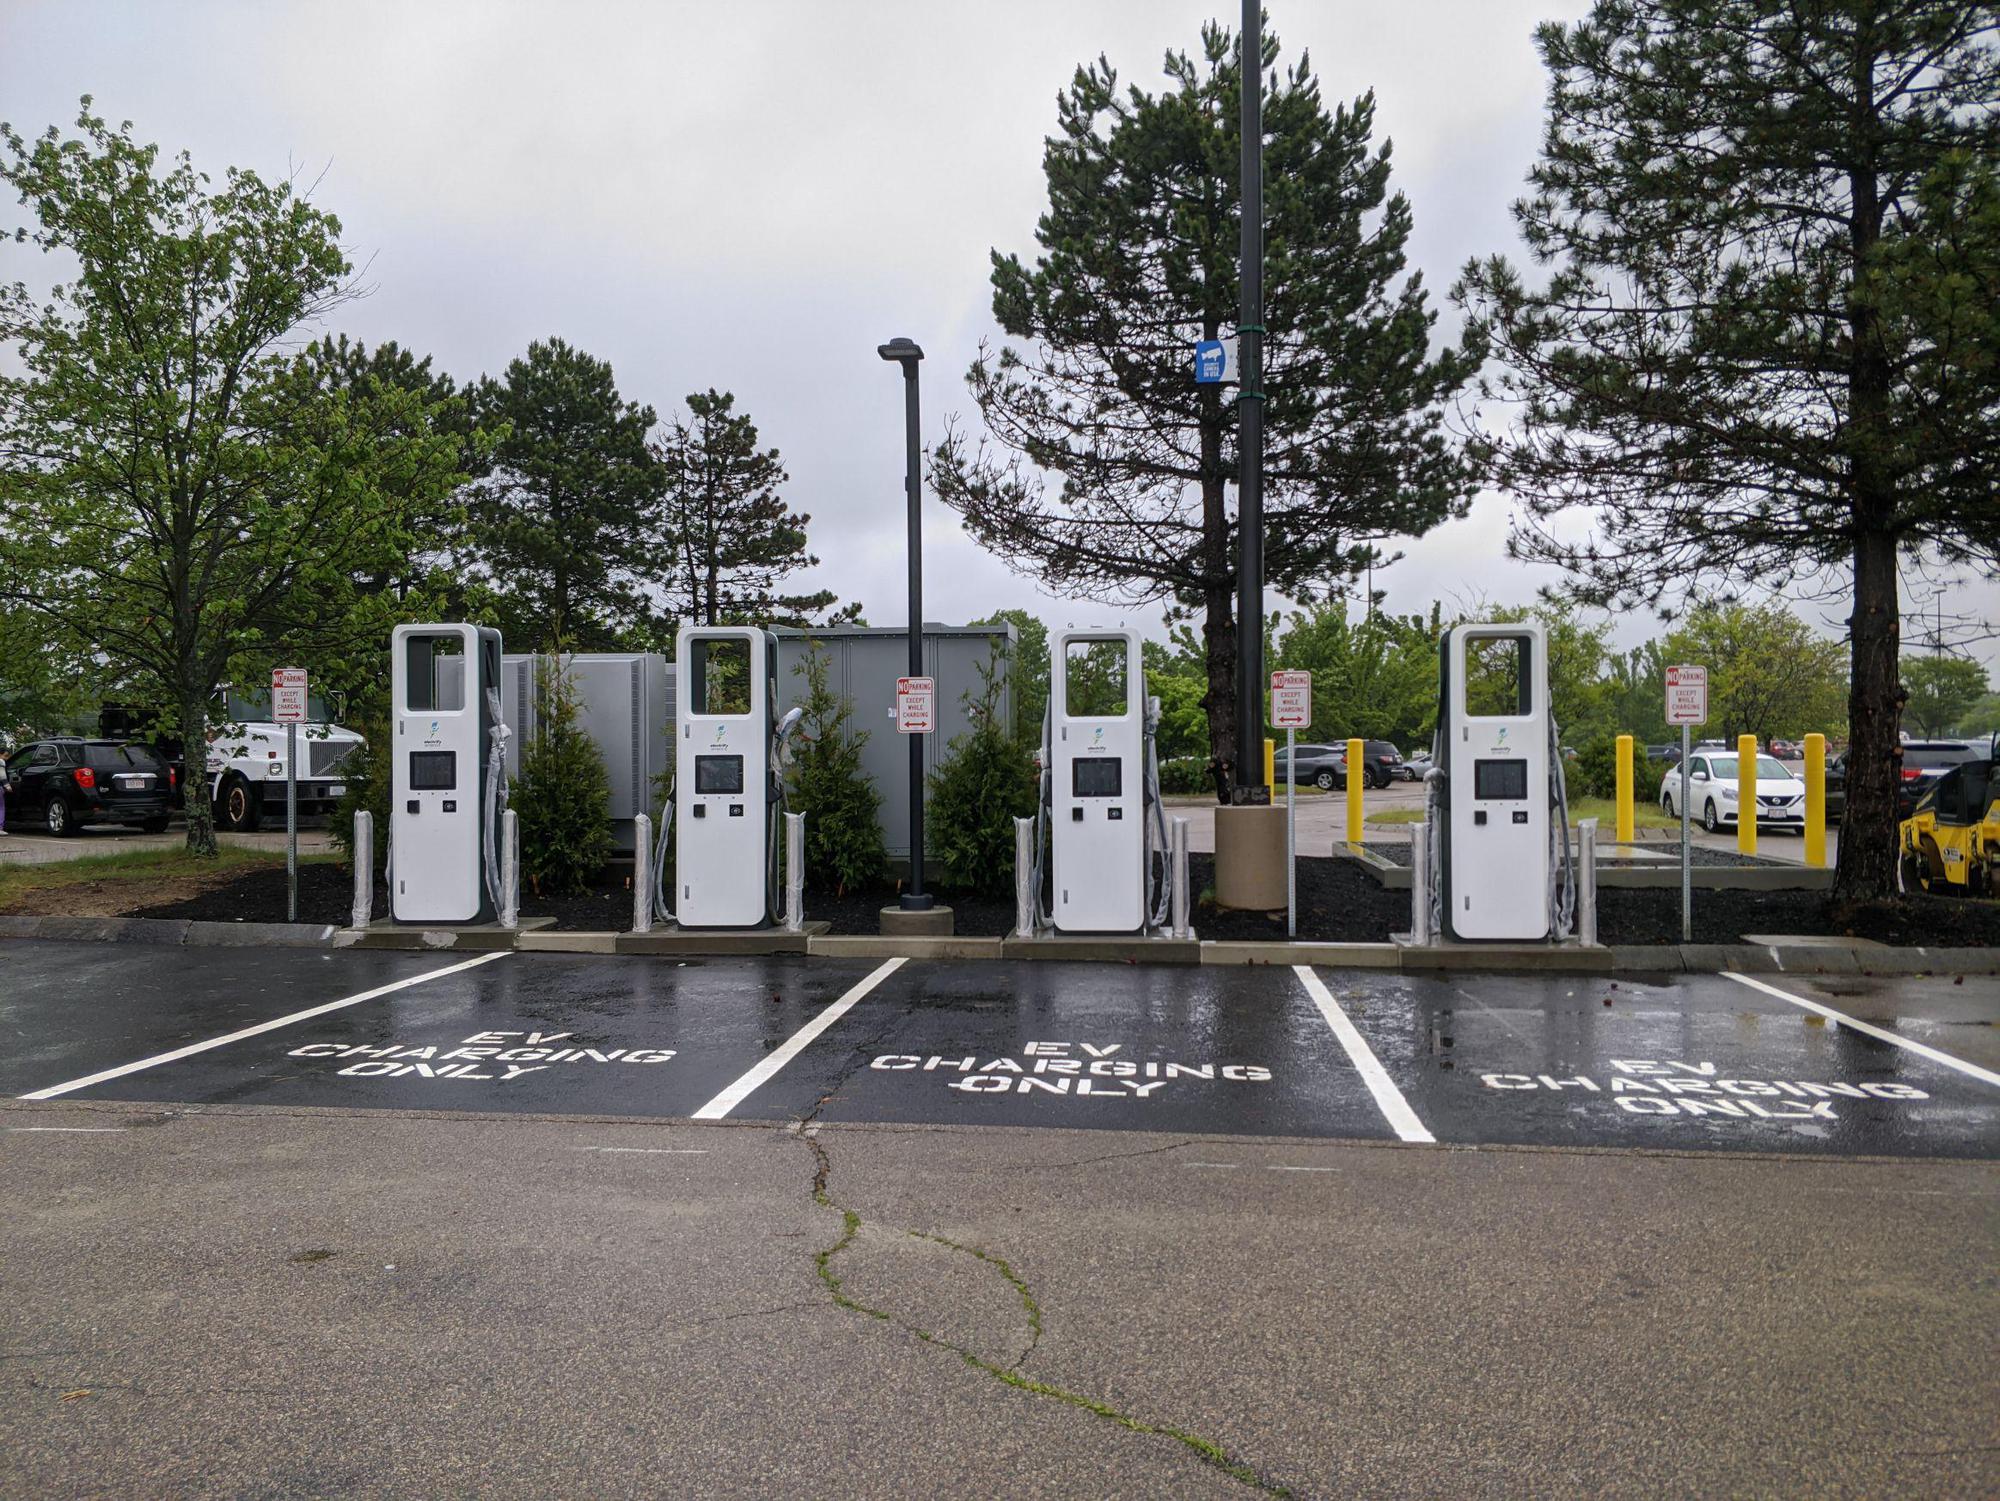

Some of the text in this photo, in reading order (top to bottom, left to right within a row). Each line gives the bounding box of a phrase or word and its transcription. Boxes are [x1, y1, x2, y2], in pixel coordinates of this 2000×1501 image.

[273, 674, 283, 684] NO
[1273, 675, 1284, 686] NO
[1668, 671, 1679, 682] NO
[899, 681, 908, 692] NO
[461, 1031, 574, 1045] EV
[287, 1043, 678, 1063] CHARGING
[1024, 1041, 1121, 1057] EV
[337, 1061, 551, 1080] ONLY
[870, 1054, 1272, 1081] CHARGING
[1609, 1059, 1717, 1075] EV
[957, 1075, 1167, 1097] ONLY
[1480, 1073, 1930, 1099] CHARGING
[1614, 1096, 1839, 1119] ONLY
